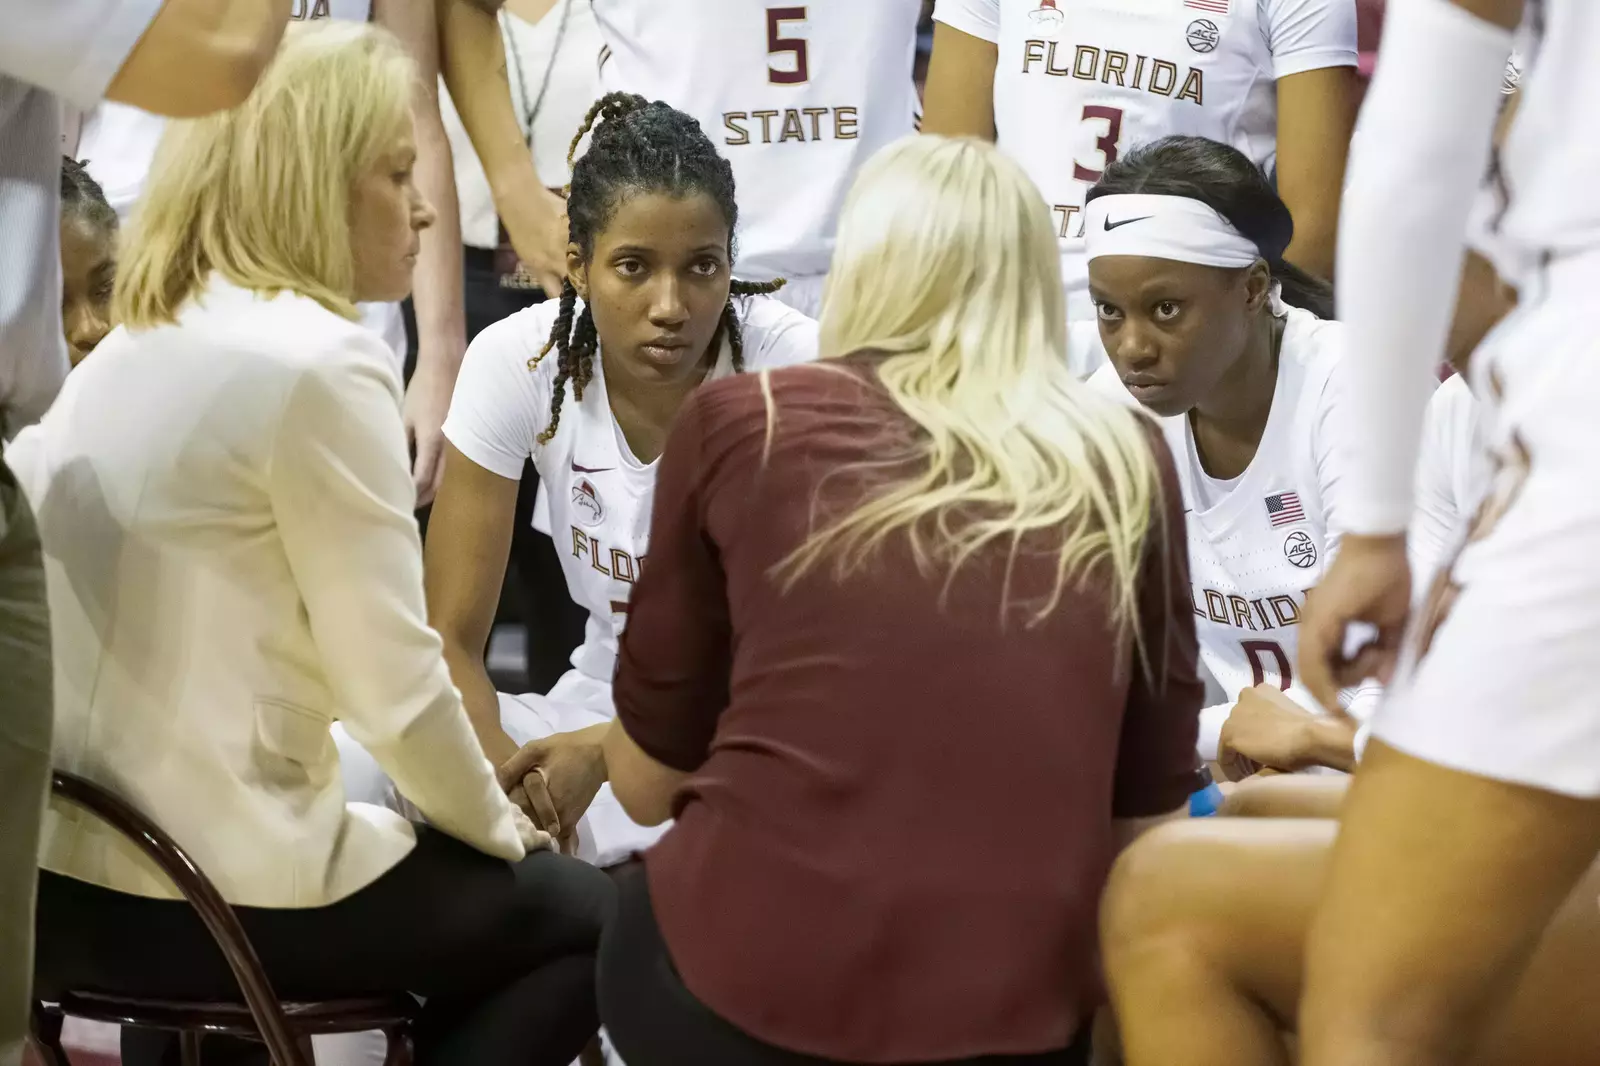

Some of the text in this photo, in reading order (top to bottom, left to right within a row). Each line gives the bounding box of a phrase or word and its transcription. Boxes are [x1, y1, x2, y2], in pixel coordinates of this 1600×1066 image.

[765, 6, 809, 86] 5
[1022, 40, 1203, 105] FLORIDA
[722, 106, 858, 145] STATE
[1073, 105, 1123, 182] 3
[1189, 581, 1311, 631] LORID
